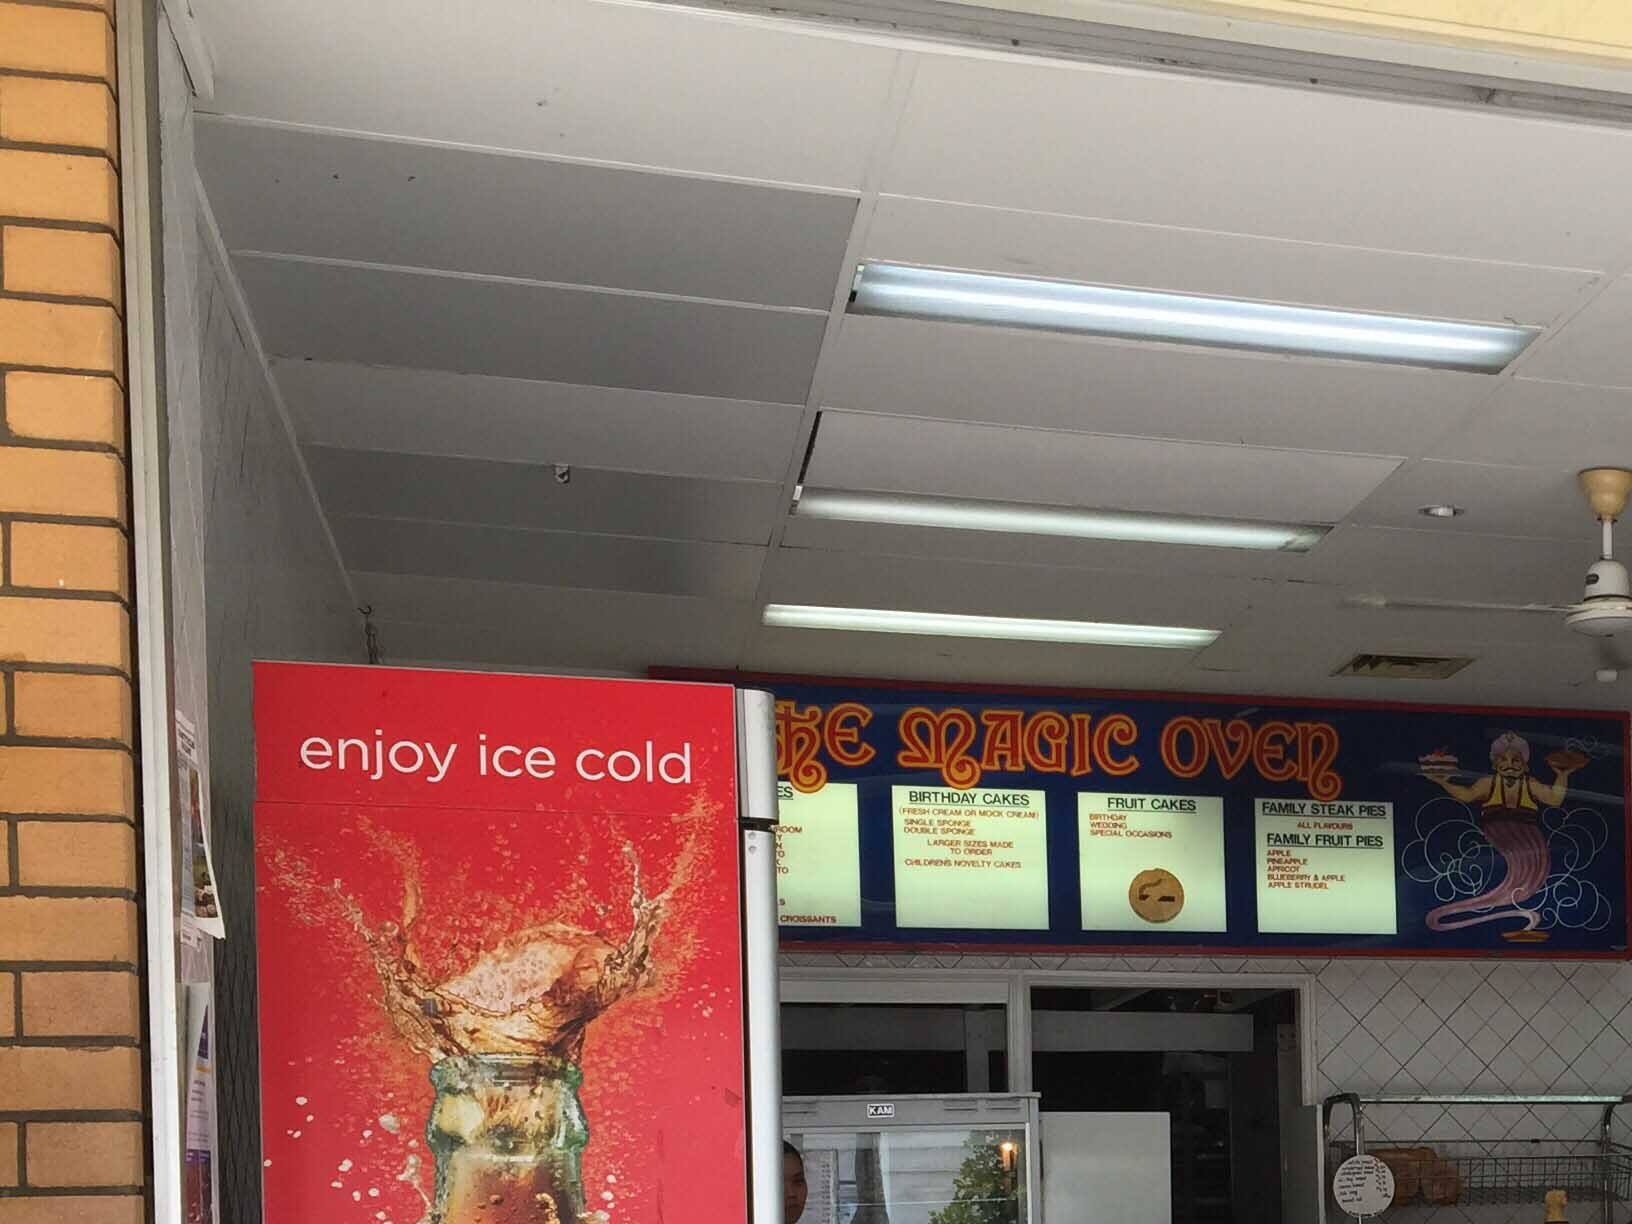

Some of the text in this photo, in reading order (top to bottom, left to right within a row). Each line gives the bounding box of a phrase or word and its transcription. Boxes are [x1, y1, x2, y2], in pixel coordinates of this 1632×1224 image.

[776, 699, 876, 793] HE
[897, 704, 1140, 789] MAGIC
[300, 729, 692, 784] enjoy ice cold
[909, 791, 1030, 806] BIRTHDAY CAKES
[1107, 798, 1196, 810] FRUIT CAKES
[932, 808, 962, 816] CREAM
[978, 810, 1004, 818] MOCK
[1262, 802, 1386, 816] FAMILY STEAK PIES
[1314, 822, 1353, 830] FLAVOURS
[927, 839, 961, 847] LARGER
[1267, 833, 1384, 846] FAMILY FRUIT PIES
[964, 848, 992, 856] ORDER
[954, 860, 991, 868] NOVELTY
[780, 915, 836, 923] CROISSANTS
